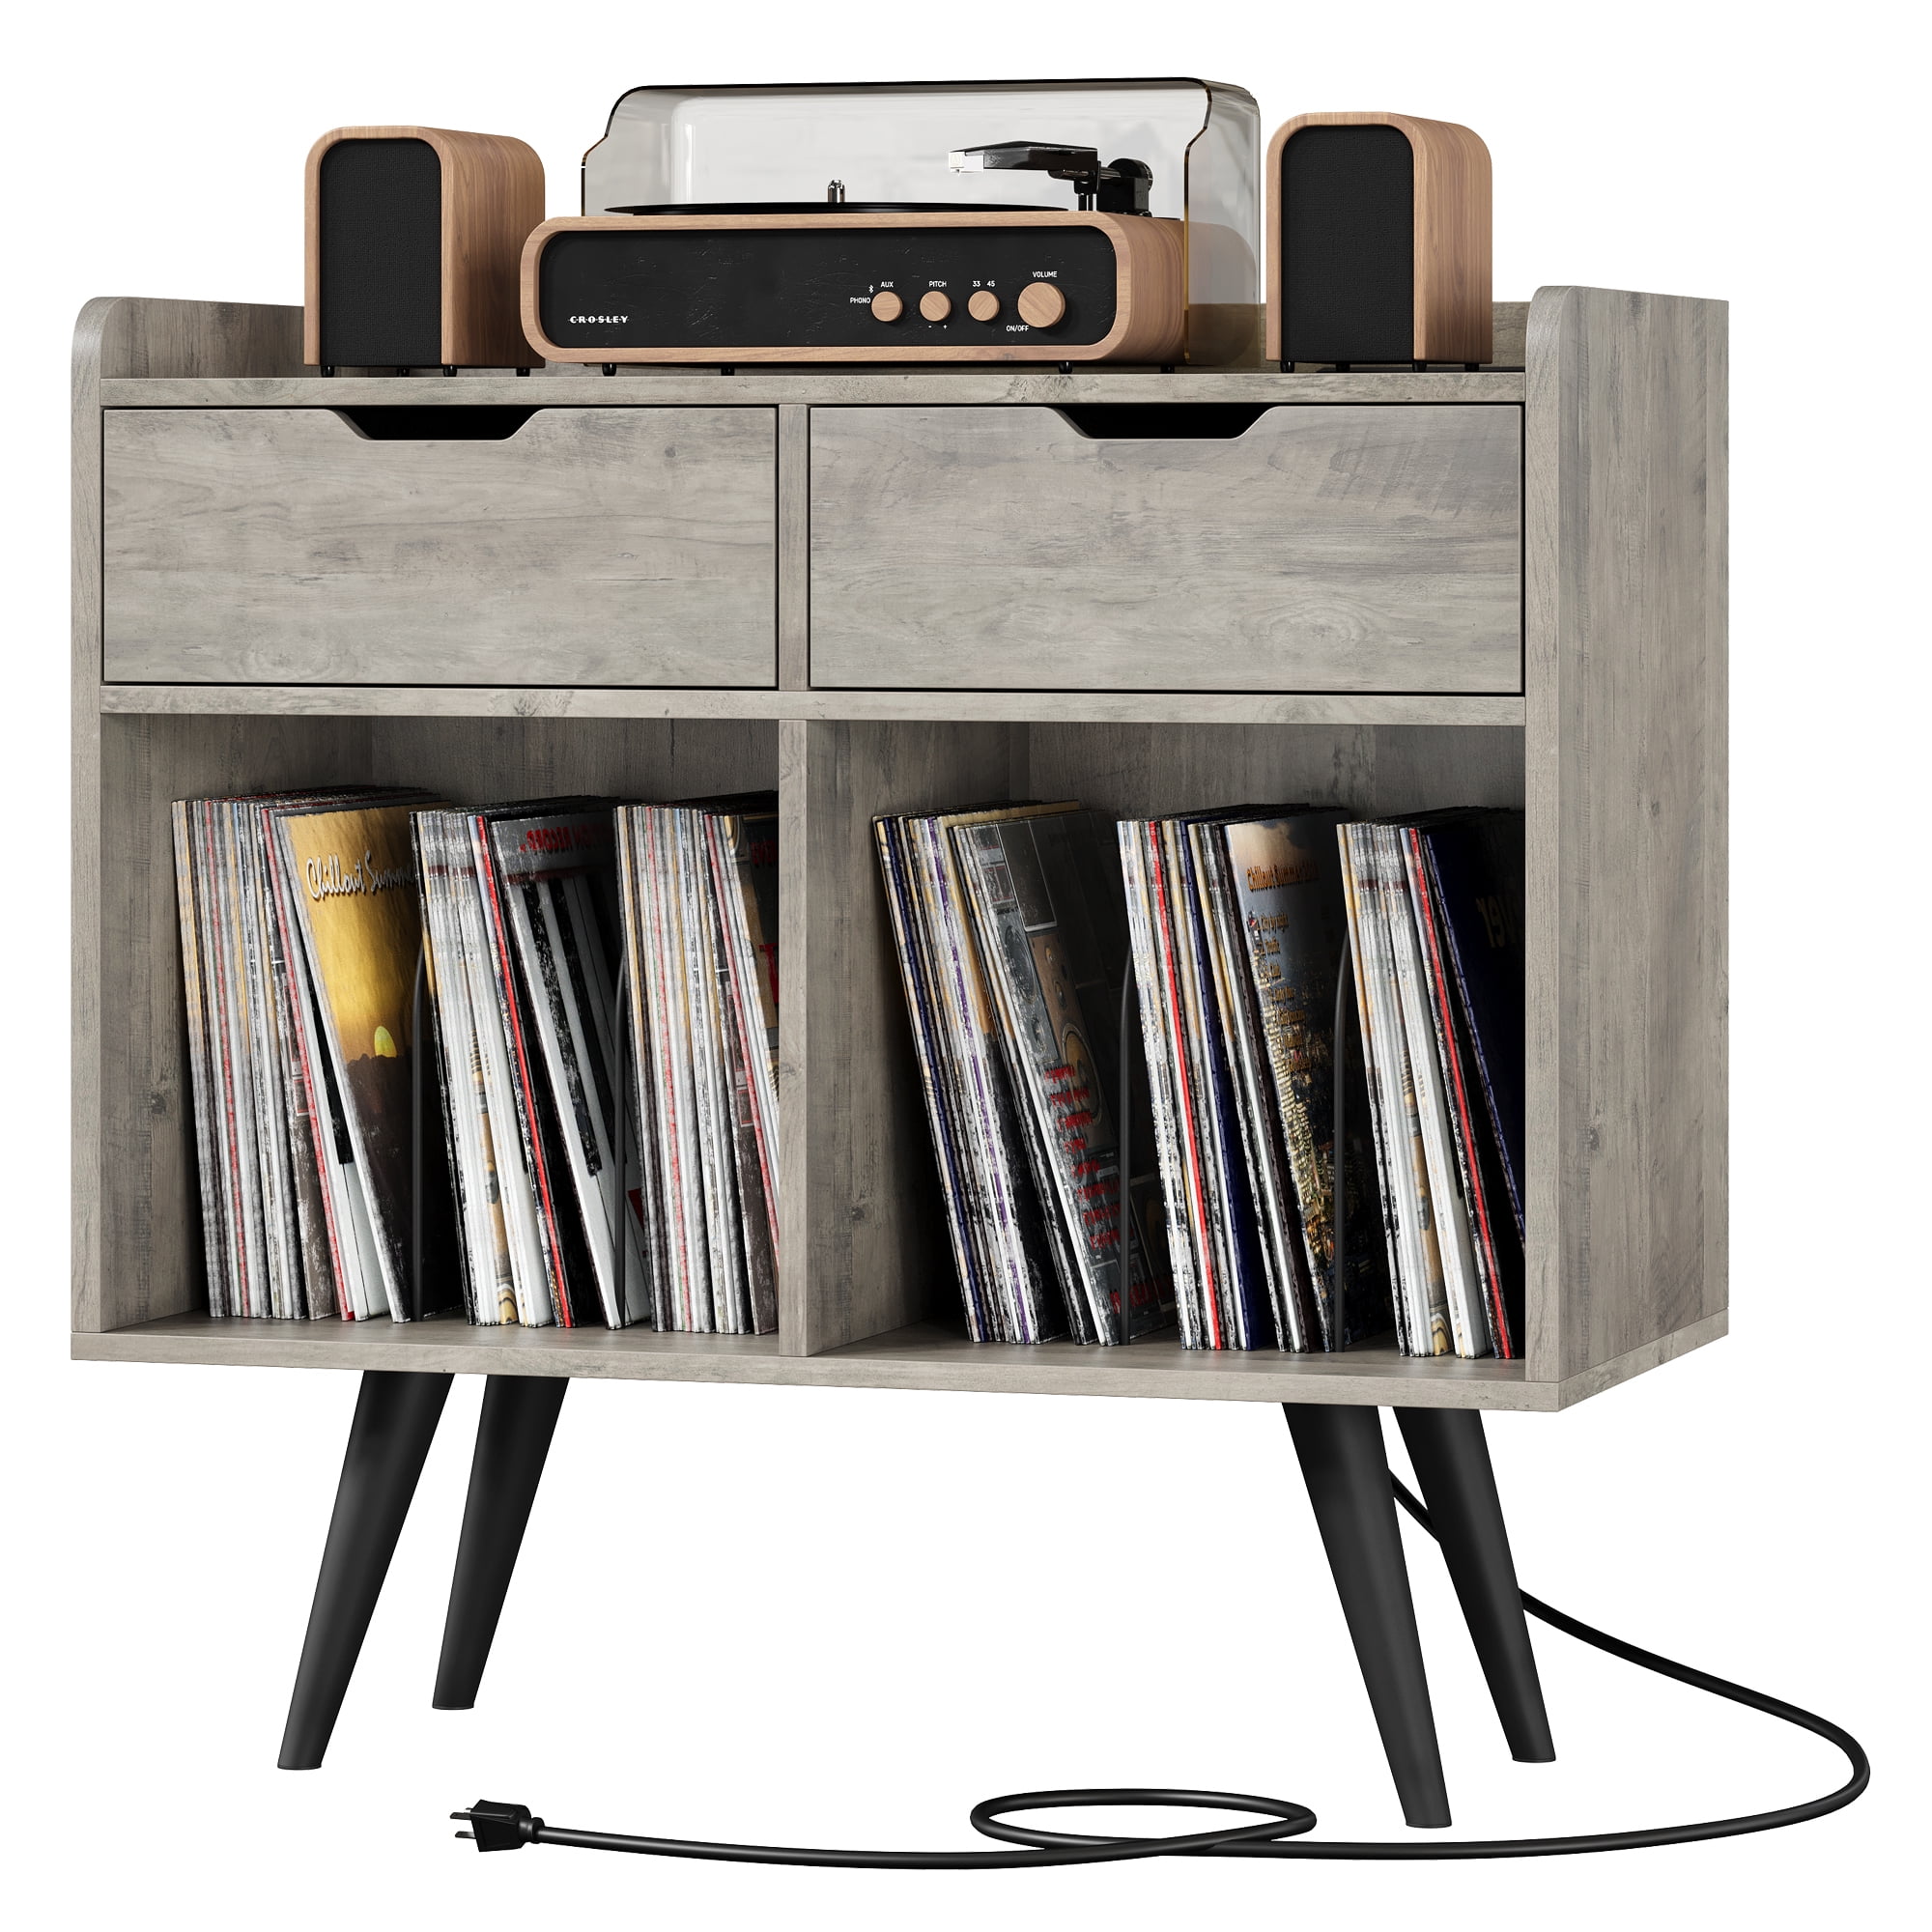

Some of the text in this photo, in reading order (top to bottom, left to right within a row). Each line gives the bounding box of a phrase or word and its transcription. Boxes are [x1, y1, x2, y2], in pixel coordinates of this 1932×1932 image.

[568, 315, 629, 324] CROSLEY
[1006, 324, 1030, 332] ON/OFF
[306, 853, 366, 900] Chillout
